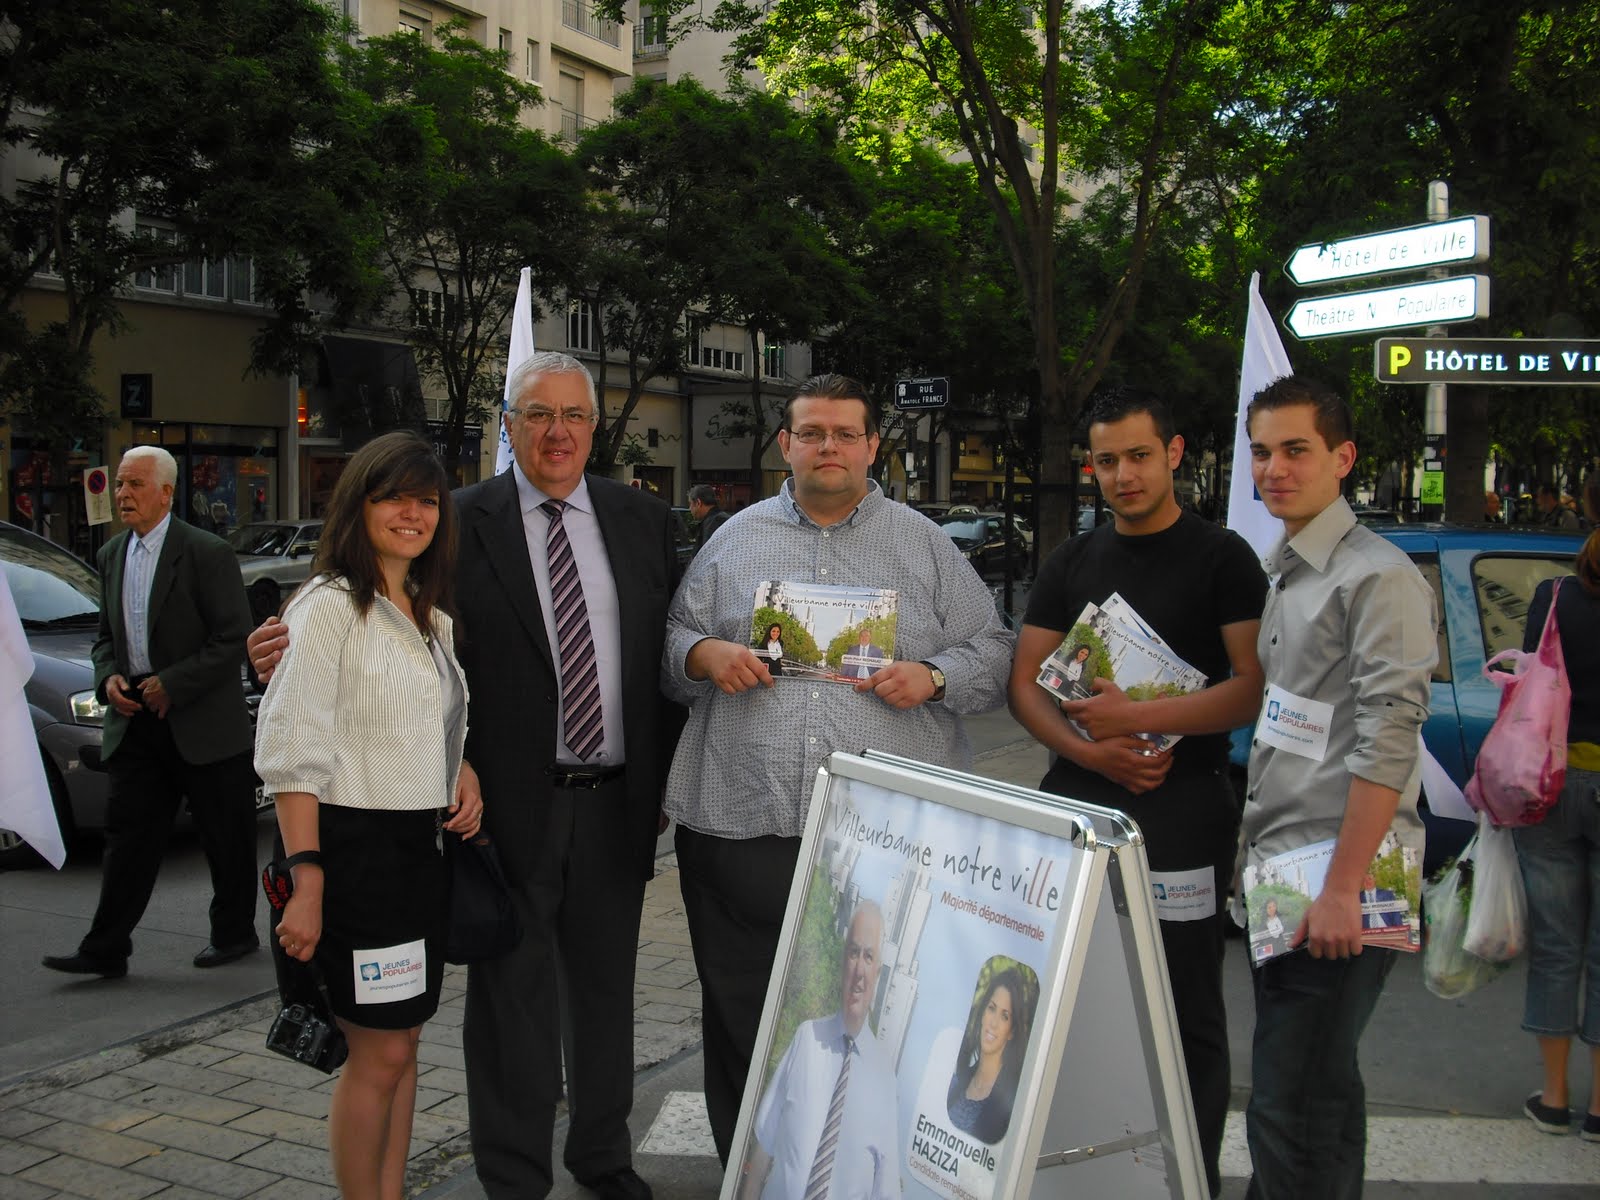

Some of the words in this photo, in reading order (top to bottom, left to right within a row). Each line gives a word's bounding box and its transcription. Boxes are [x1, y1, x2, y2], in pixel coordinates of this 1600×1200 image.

[1388, 239, 1409, 261] de
[1423, 231, 1468, 255] Ville
[1366, 301, 1377, 321] N
[1425, 349, 1508, 372] HÔTEL
[1519, 354, 1550, 371] DE
[920, 385, 934, 393] RUE
[922, 395, 943, 403] FRANCE
[777, 595, 829, 607] Villeurbanne
[832, 599, 856, 609] notre
[1101, 617, 1145, 653] Villeurbanne
[1147, 651, 1170, 667] notre
[1278, 714, 1324, 734] POPULAIRES
[1280, 708, 1308, 722] JEUNES
[833, 804, 932, 866] Villeurbanne
[943, 846, 1002, 892] notre
[1011, 857, 1060, 912] ville
[1167, 883, 1197, 893] JEUNES
[1167, 887, 1212, 899] POPULAIRES
[940, 890, 979, 917] Majorité
[979, 906, 1045, 942] départementale
[382, 958, 410, 970] JEUNES
[382, 962, 423, 977] POPULAIRES
[916, 1113, 995, 1172] Emmanuelle
[912, 1134, 959, 1178] HAZIZA
